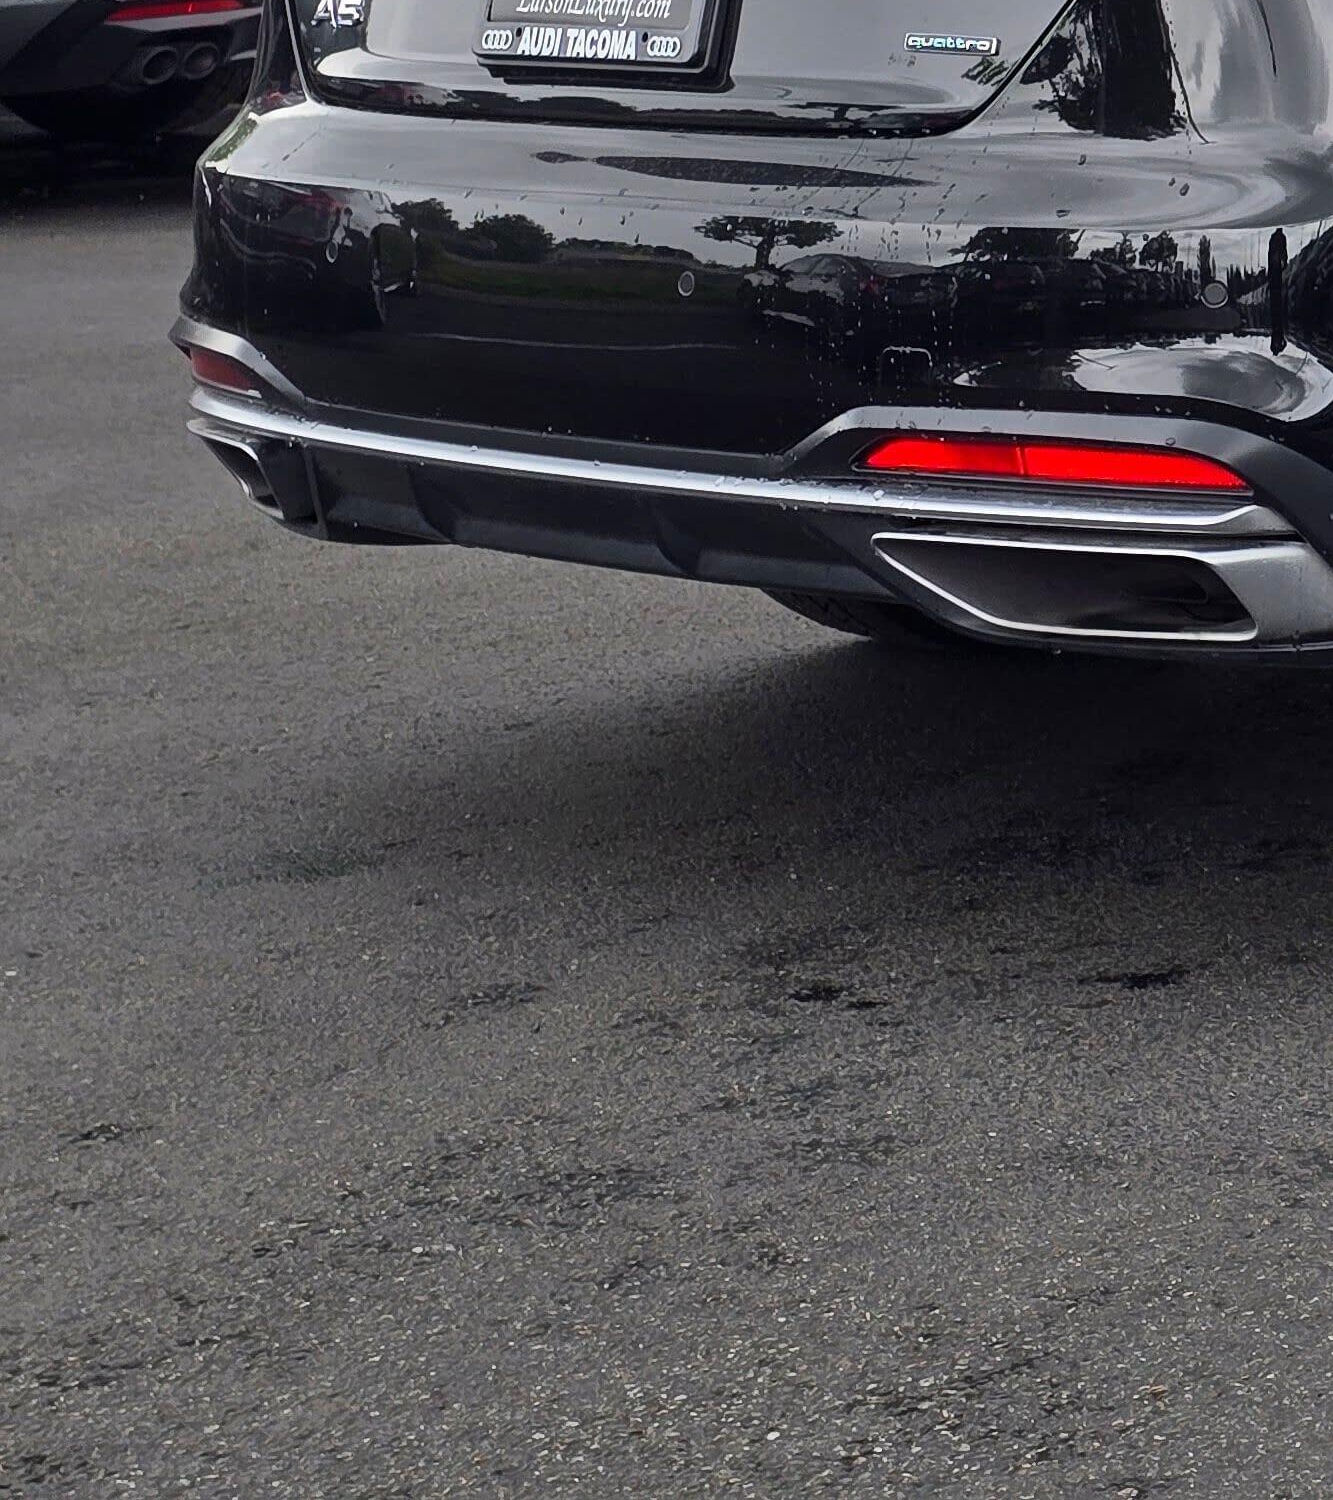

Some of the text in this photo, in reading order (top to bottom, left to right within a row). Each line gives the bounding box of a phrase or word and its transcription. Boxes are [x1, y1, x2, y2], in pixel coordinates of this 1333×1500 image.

[517, 26, 637, 60] AUDI TACOMA
[907, 36, 991, 51] quattro
